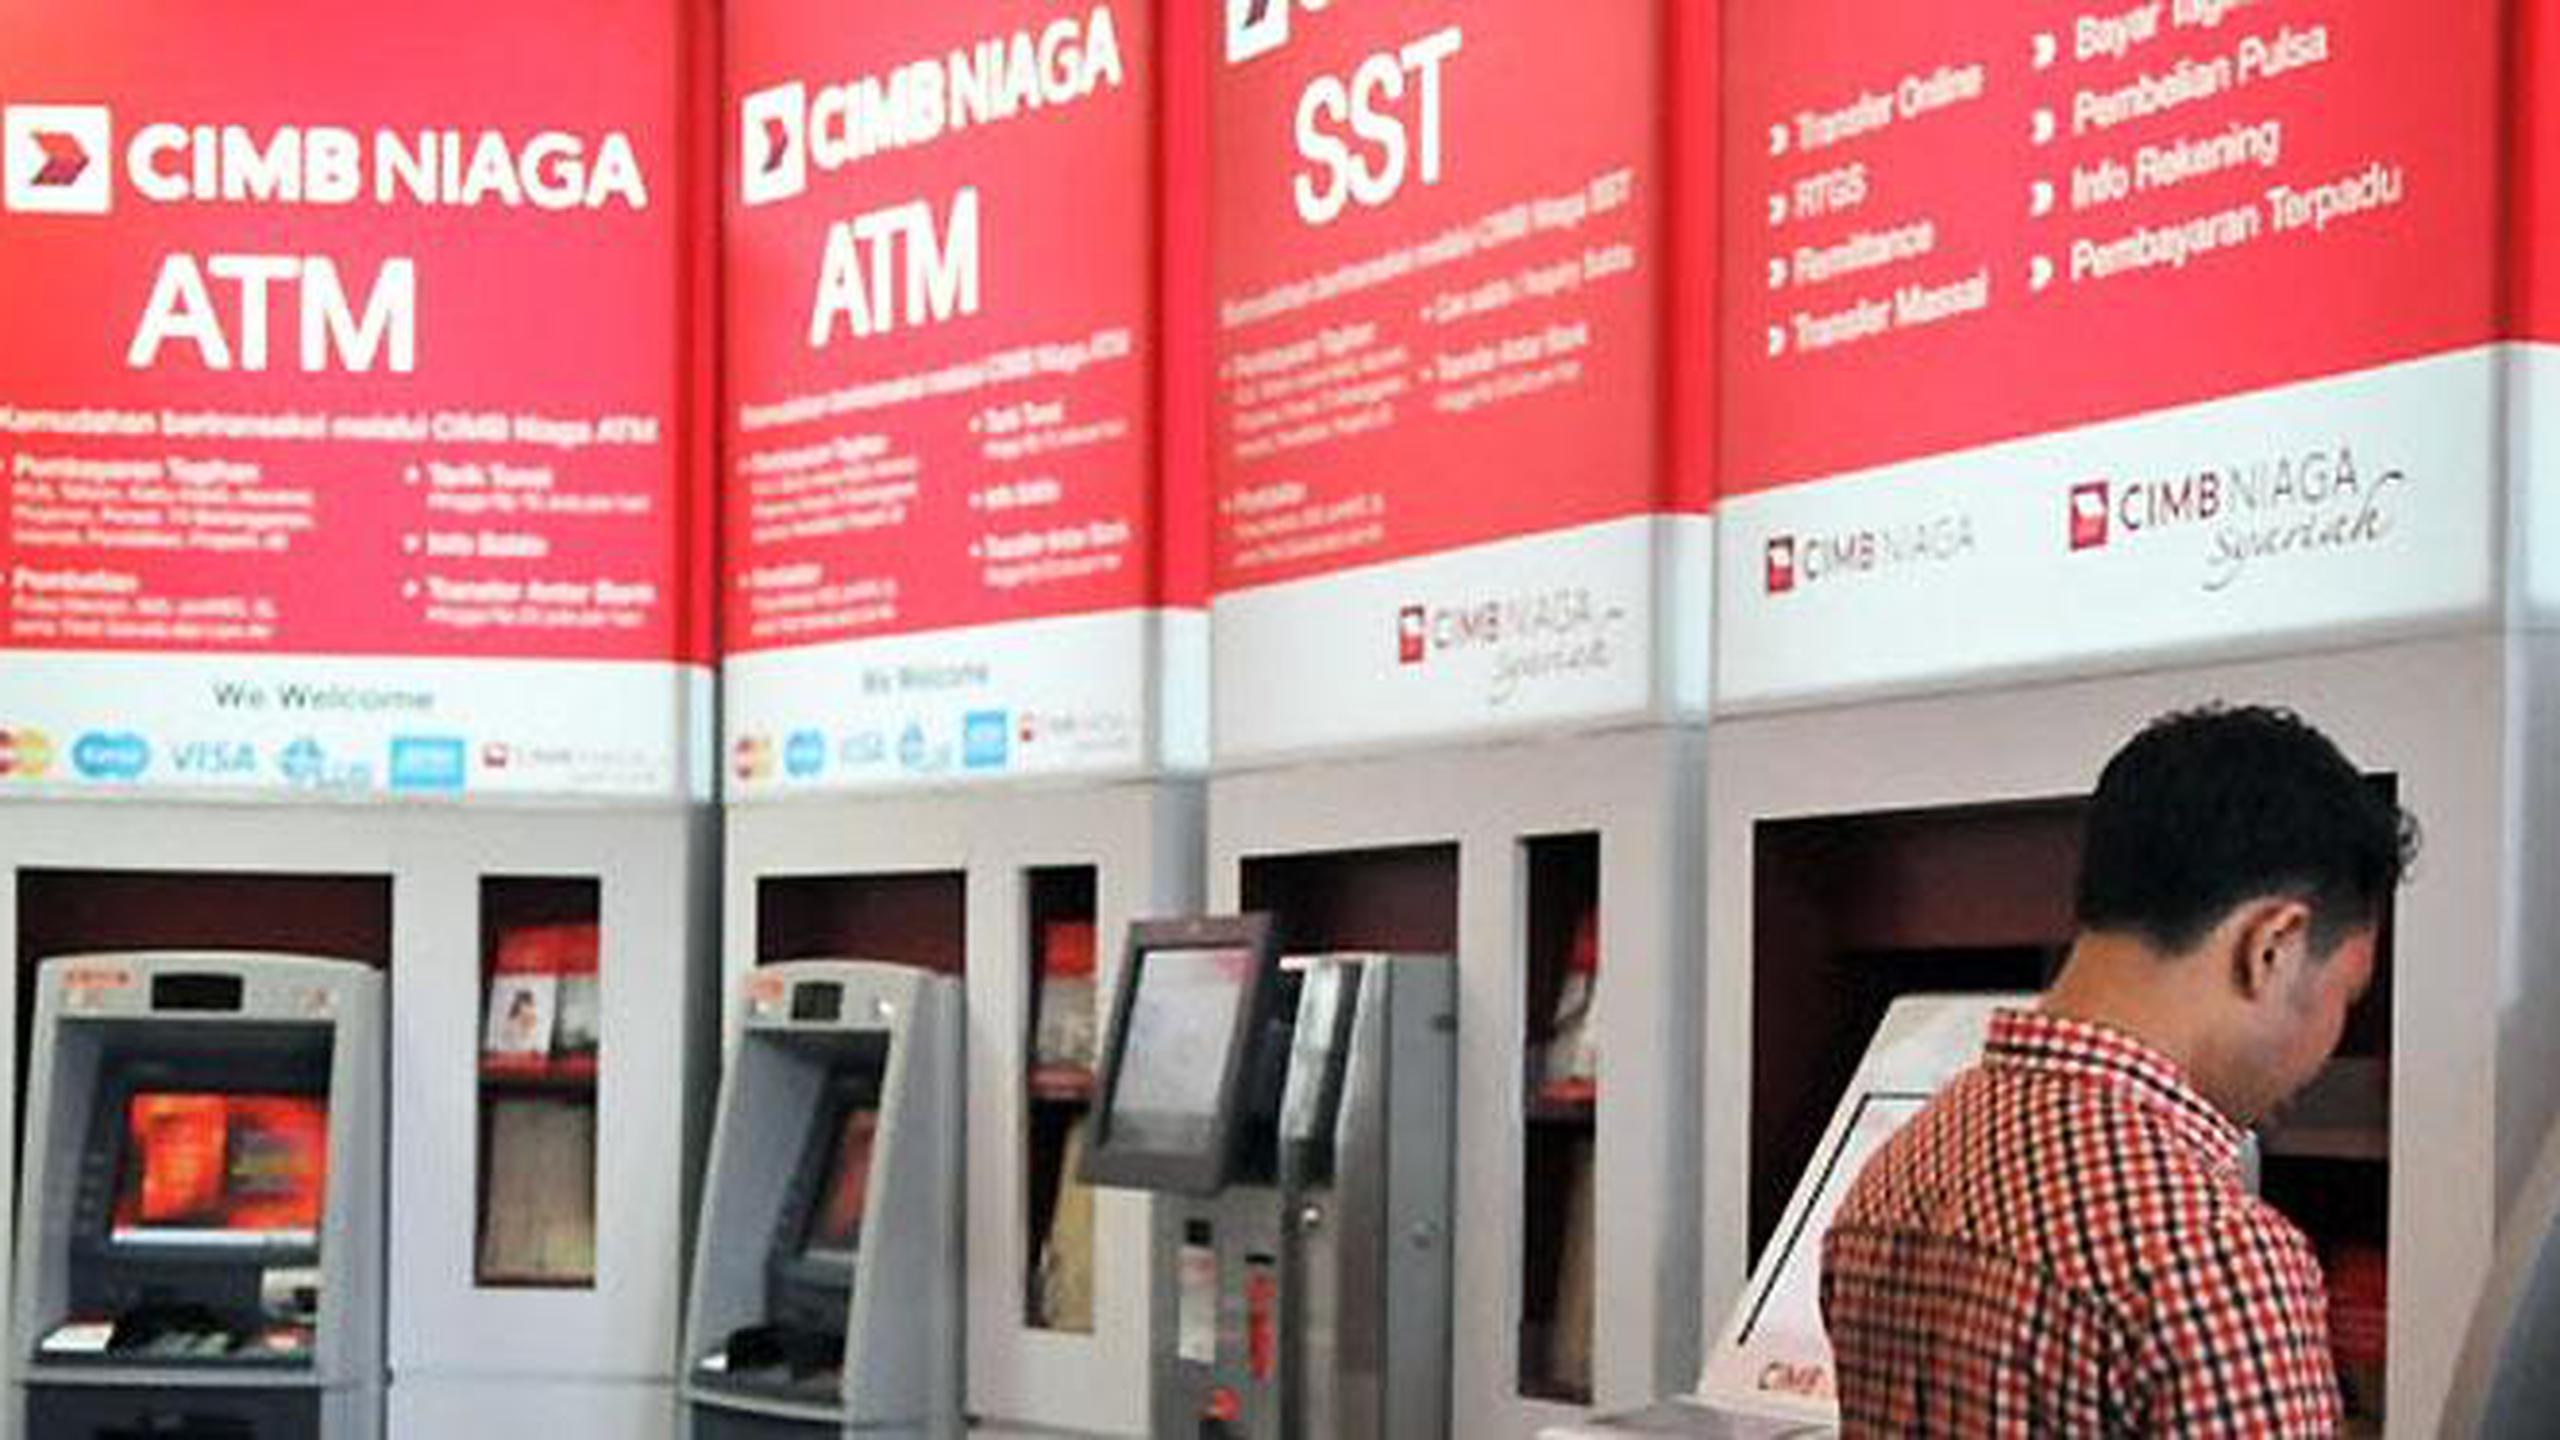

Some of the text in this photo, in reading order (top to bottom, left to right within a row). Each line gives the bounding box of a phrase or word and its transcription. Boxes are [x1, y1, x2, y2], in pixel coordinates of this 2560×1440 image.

[809, 4, 1123, 170] CIMB NIAGA
[1293, 24, 1463, 227] SST
[1795, 62, 1986, 153] Transfer Online
[2072, 24, 2329, 136] Pembelian Pulsa
[125, 122, 650, 209] CIMB NIAGA
[2071, 120, 2282, 210] Info Rekening
[808, 185, 979, 350] ATM
[2069, 160, 2404, 284] Pembayaran Terpadu
[126, 252, 417, 373] ATM
[1792, 264, 1989, 352] Transfer Massal
[2119, 447, 2359, 532] CIMB NIAGA
[214, 679, 434, 709] We Welcome
[171, 740, 257, 772] VISA
